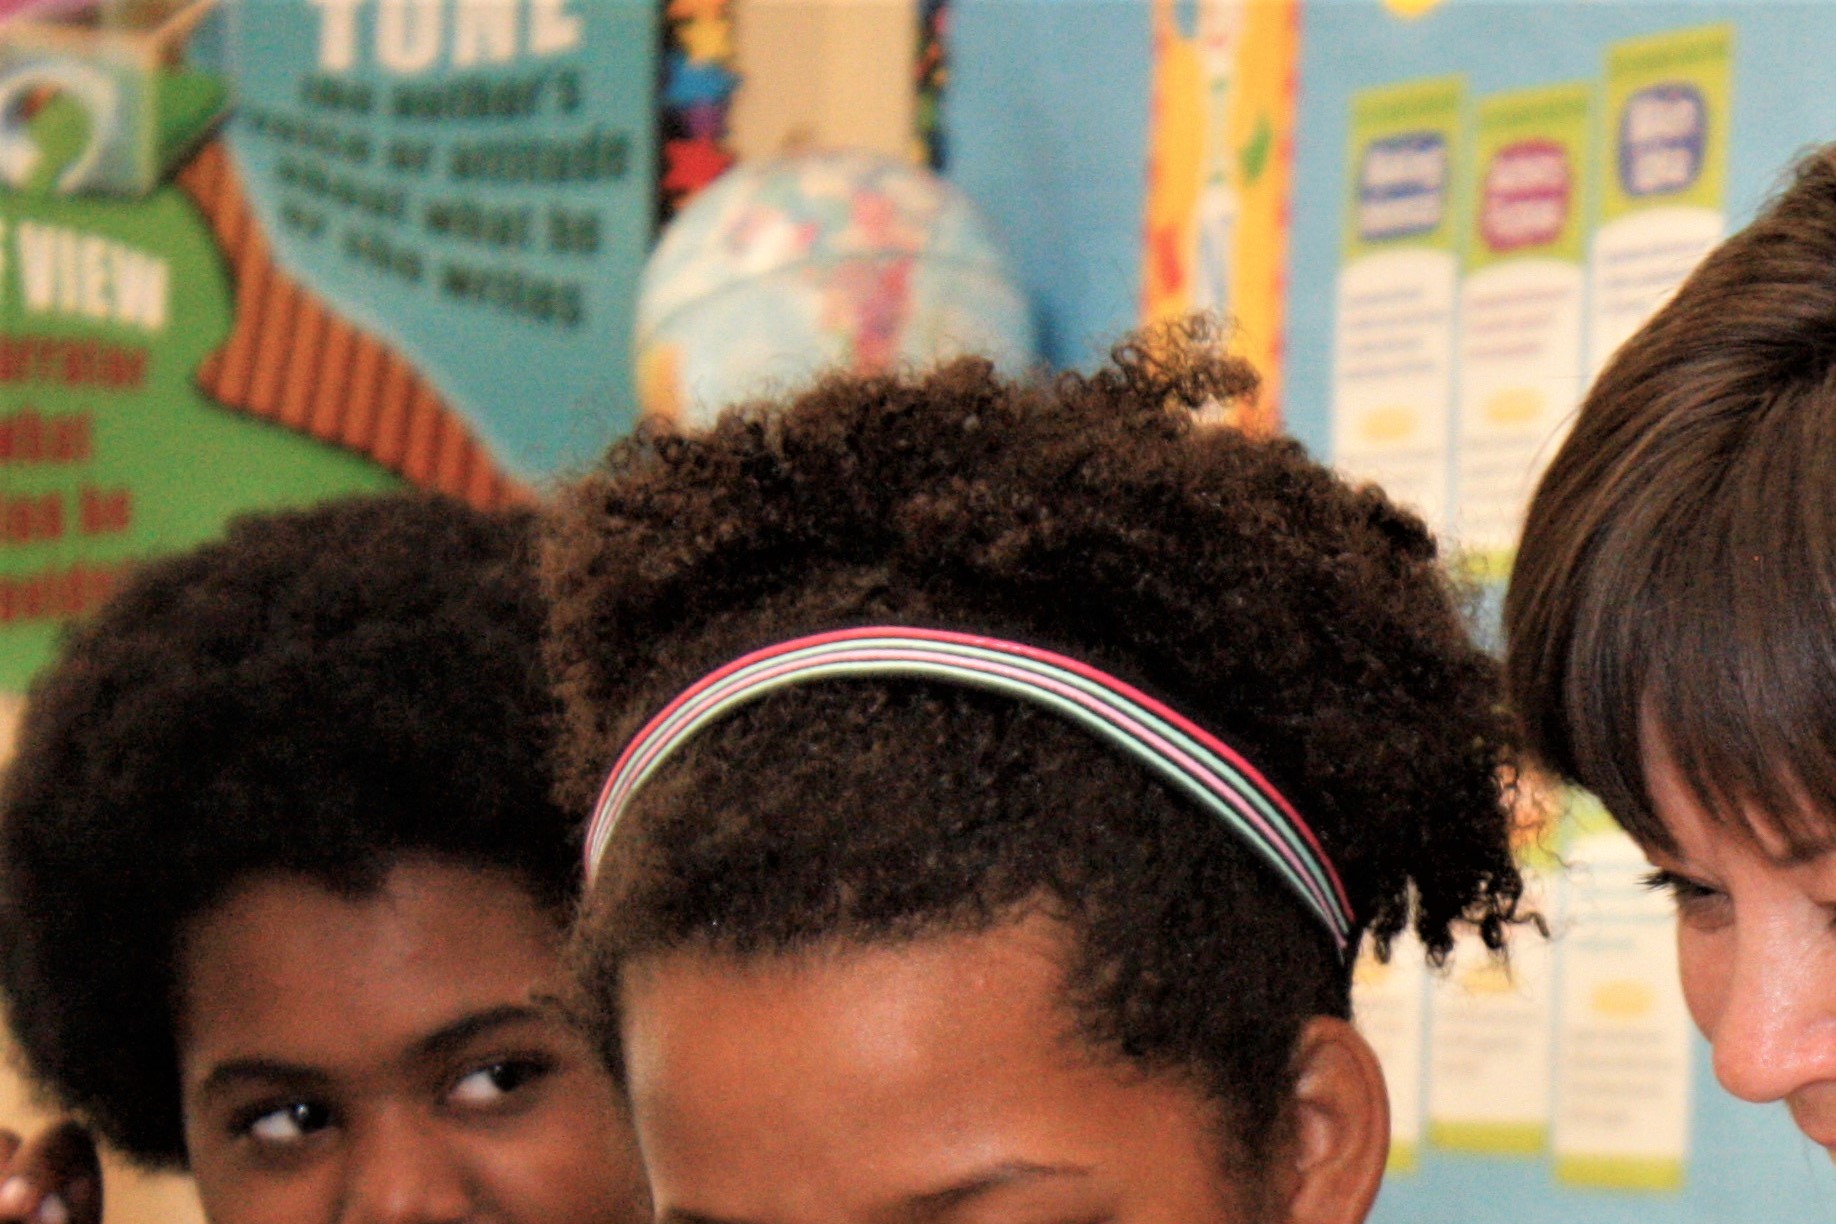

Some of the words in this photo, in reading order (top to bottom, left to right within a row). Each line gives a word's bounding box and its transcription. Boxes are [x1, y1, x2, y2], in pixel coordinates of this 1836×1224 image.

[448, 124, 630, 181] attitude
[425, 198, 531, 243] what
[17, 221, 167, 332] VIEW
[440, 264, 584, 326] writes
